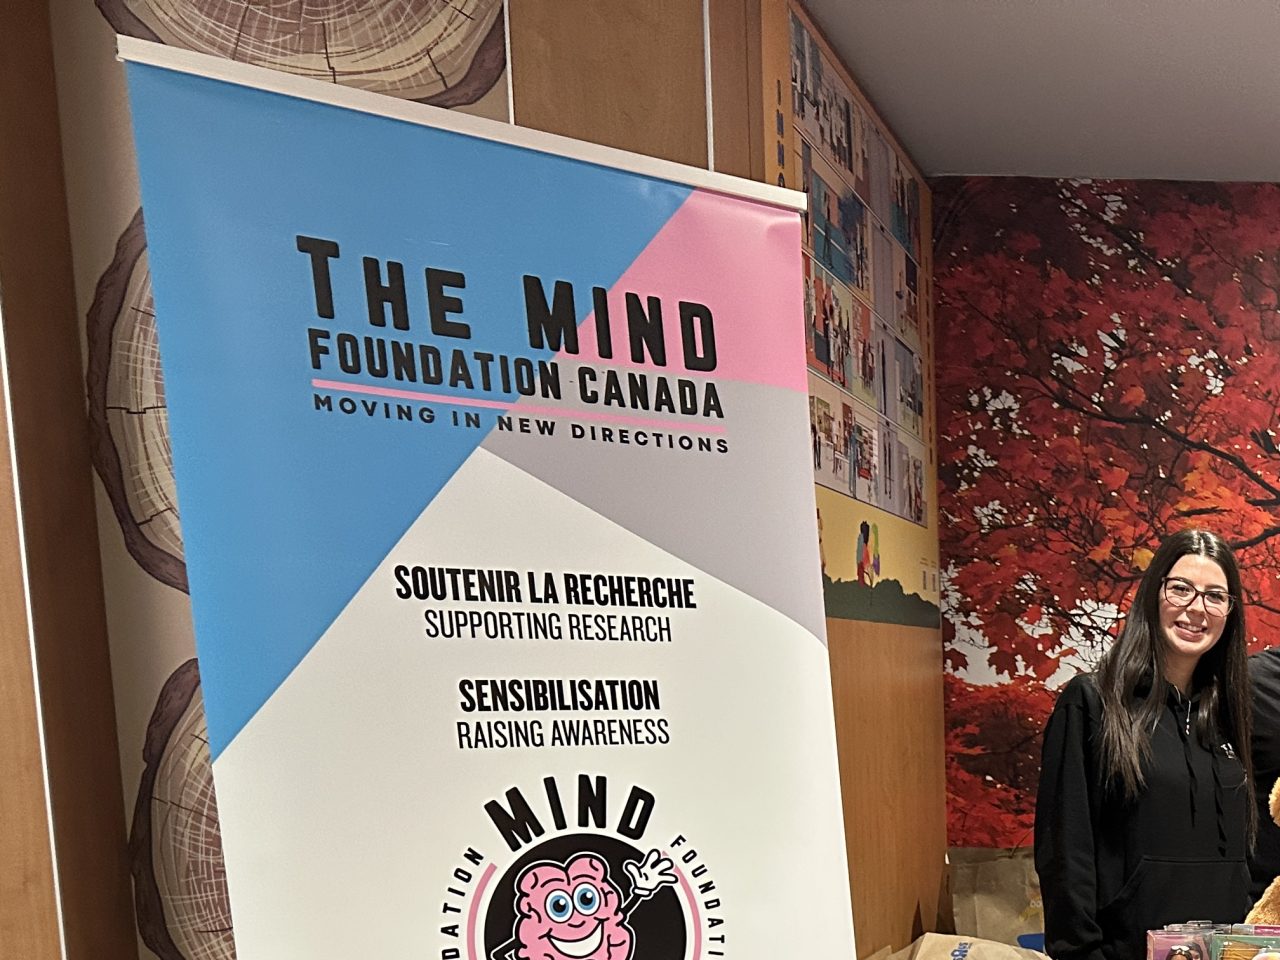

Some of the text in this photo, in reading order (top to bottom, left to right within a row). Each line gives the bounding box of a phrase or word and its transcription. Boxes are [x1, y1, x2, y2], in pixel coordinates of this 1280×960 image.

[296, 235, 719, 372] THE MIND
[307, 328, 726, 419] FOUNDATION CANADA
[313, 394, 730, 455] MOVING IN NEW DIRECTIONS
[394, 565, 697, 610] SOUTENIR LA RECHERCHE
[424, 609, 672, 644] SUPPORTING RESEARCH
[459, 679, 662, 713] SENSIBILISATION
[456, 718, 671, 750] RAISING AWARENESS
[483, 774, 657, 853] MIND
